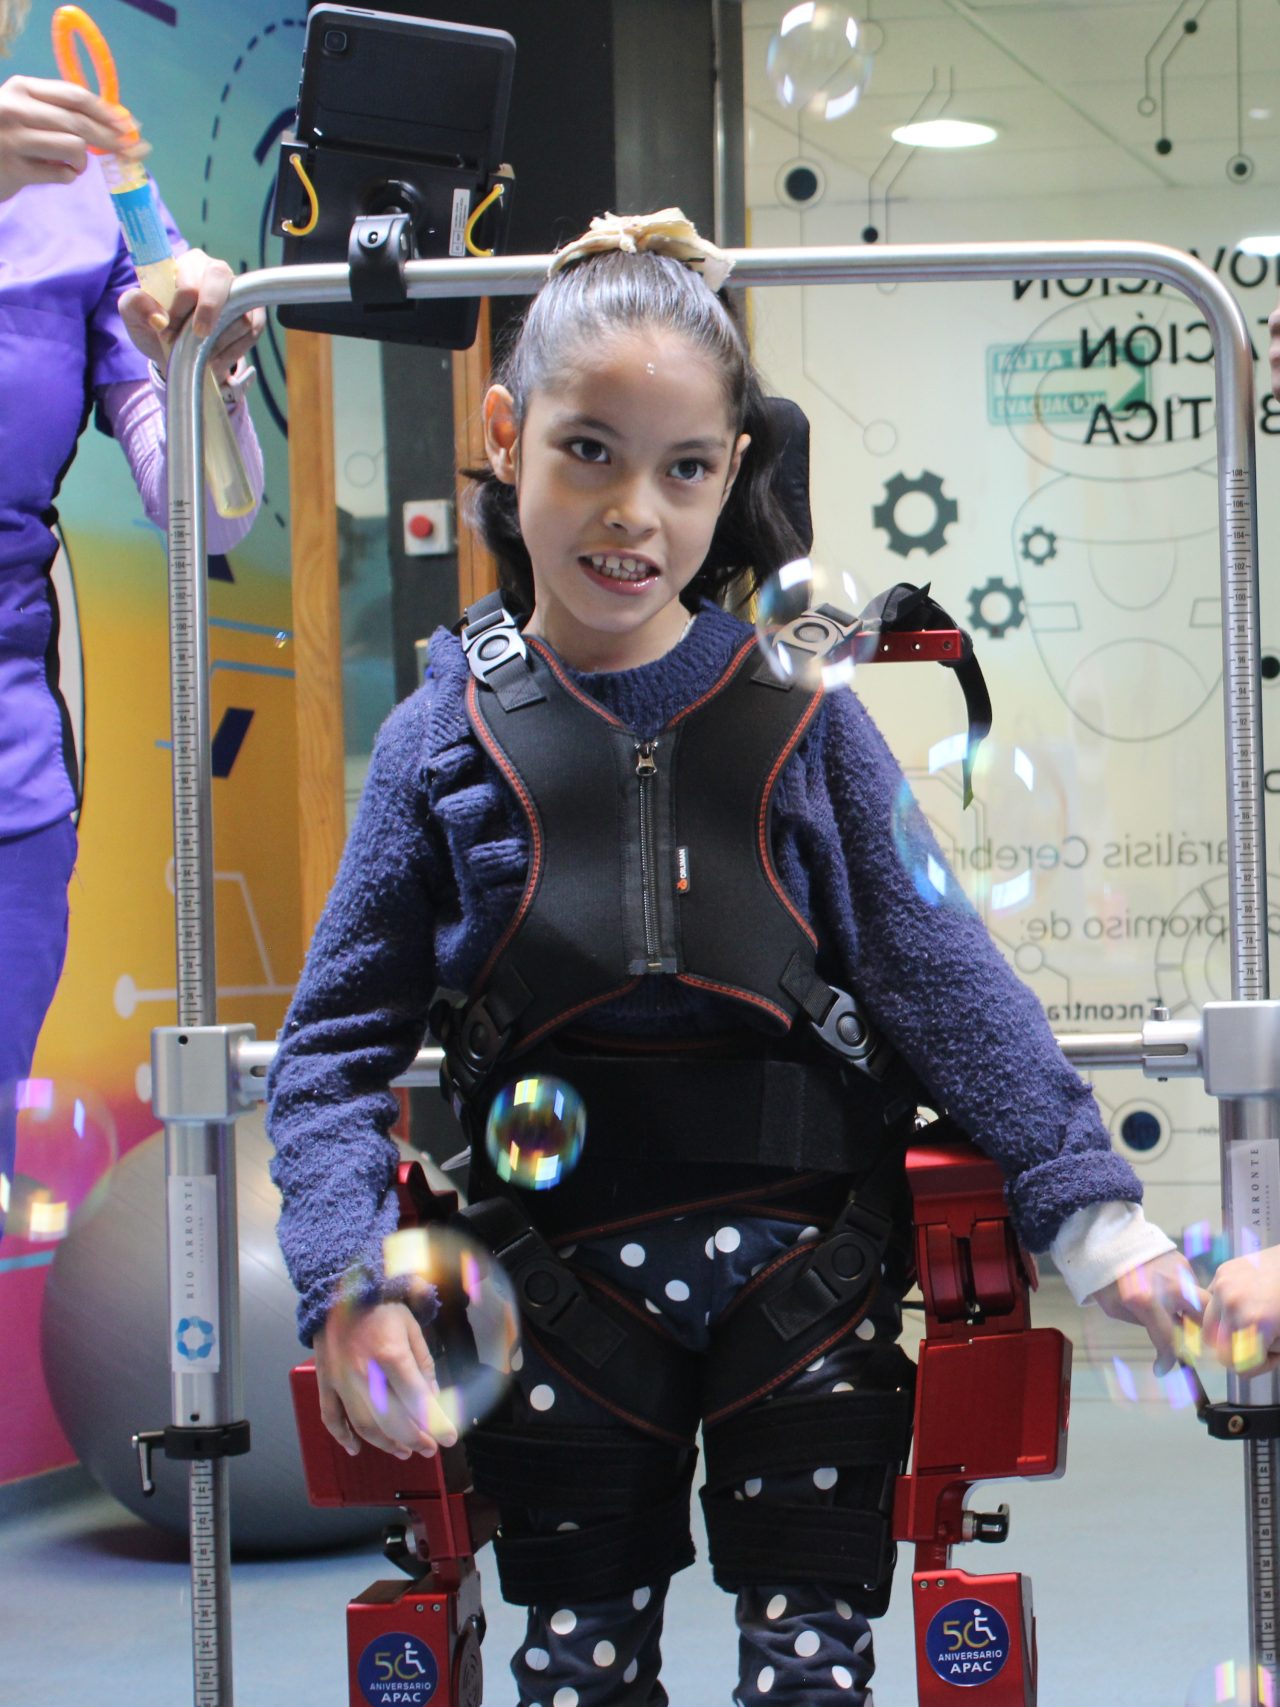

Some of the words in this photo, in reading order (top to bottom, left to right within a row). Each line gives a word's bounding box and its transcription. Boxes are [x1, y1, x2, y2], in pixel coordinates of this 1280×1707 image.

[938, 1649, 1003, 1662] ANIVERSARIO
[950, 1661, 993, 1674] APAC
[369, 1682, 432, 1691] ANIVERSARIO
[381, 1692, 421, 1703] APAC
